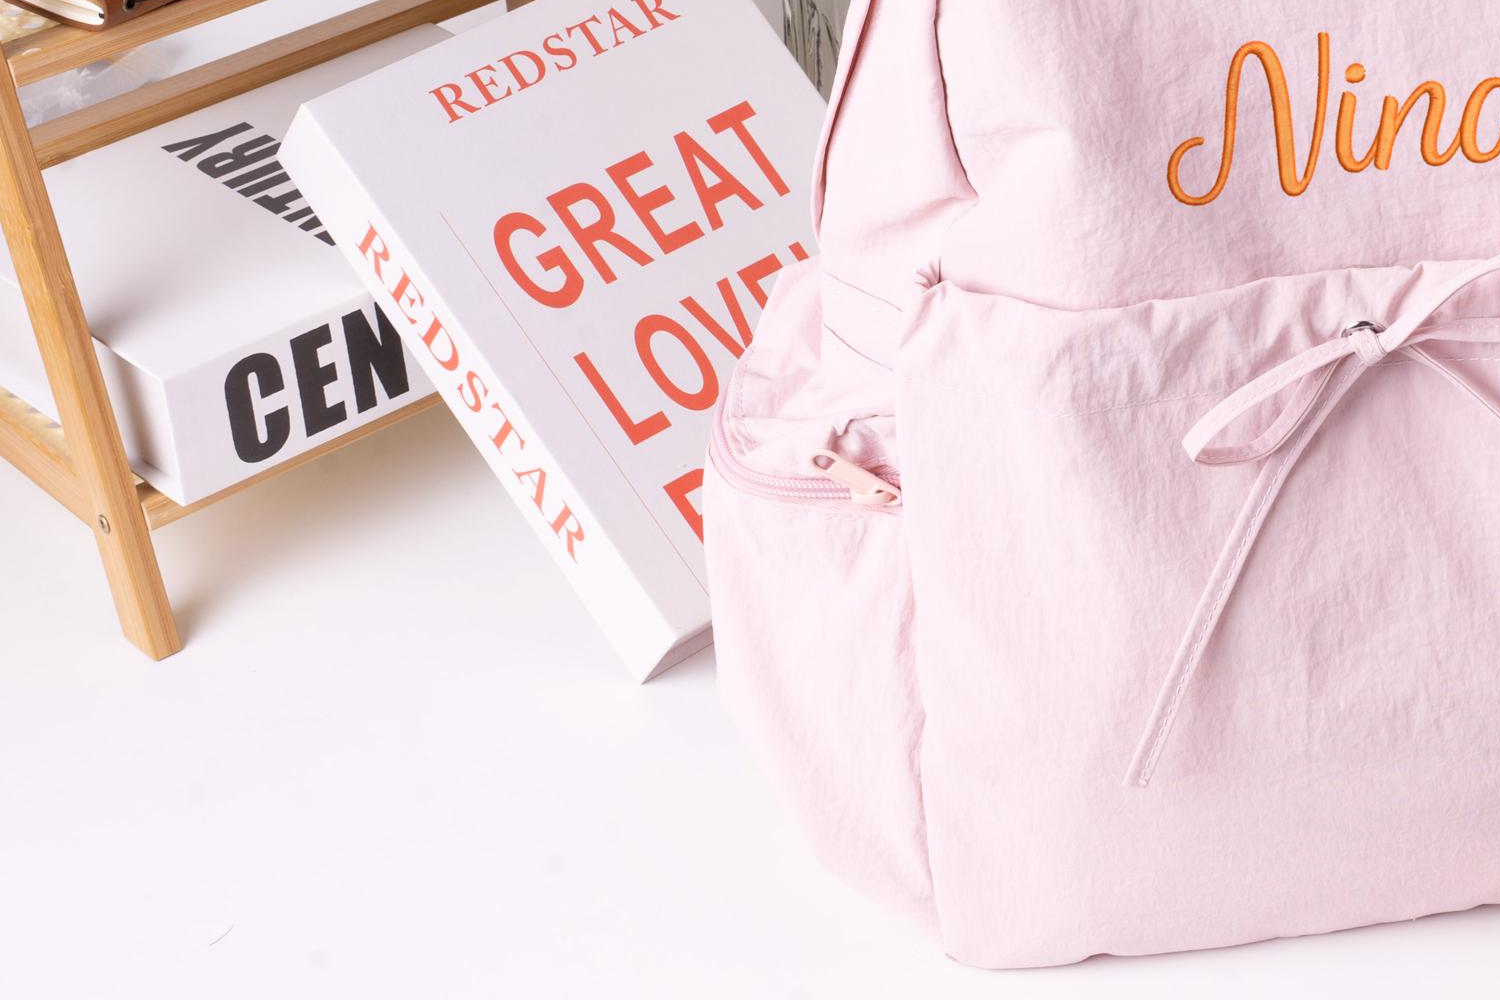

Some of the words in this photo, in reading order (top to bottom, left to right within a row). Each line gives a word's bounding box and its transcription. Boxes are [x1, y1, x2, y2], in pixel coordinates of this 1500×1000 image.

[493, 100, 791, 309] GREAT
[224, 301, 410, 463] CEN
[355, 220, 585, 564] REDSTAR
